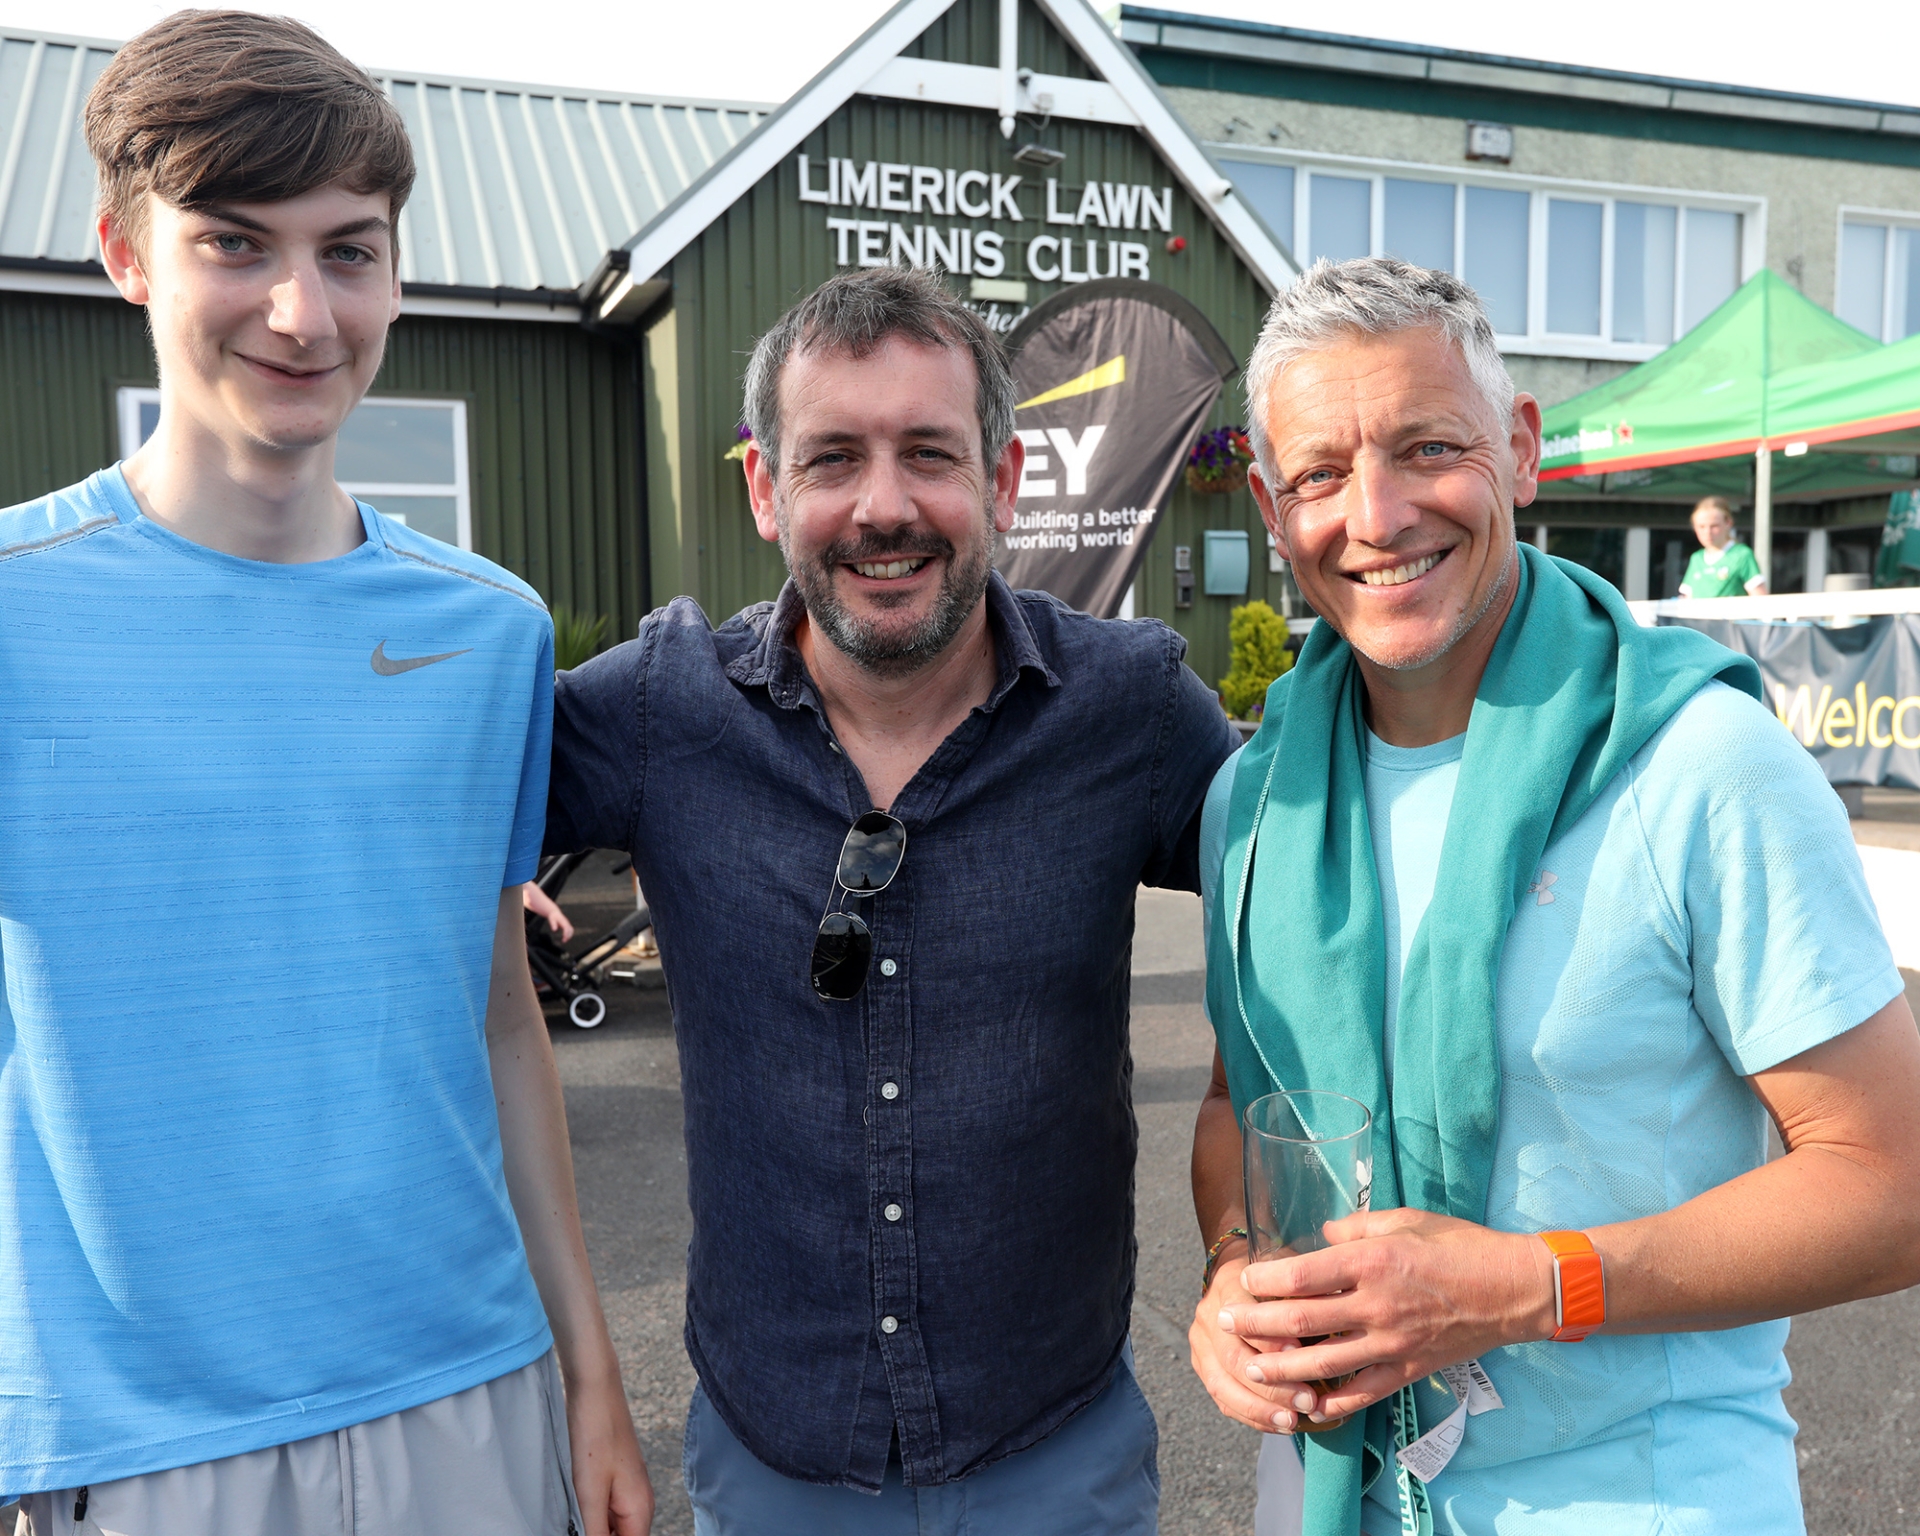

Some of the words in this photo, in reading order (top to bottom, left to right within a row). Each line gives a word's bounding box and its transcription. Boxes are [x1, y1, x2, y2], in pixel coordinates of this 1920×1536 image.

[798, 153, 1024, 222] LIMERICK
[1045, 177, 1173, 232] LAWN
[826, 216, 1006, 278] TENNIS
[1026, 234, 1151, 283] CLUB
[1013, 424, 1108, 499] EY
[1004, 530, 1078, 553] working
[1080, 526, 1134, 548] world
[1082, 512, 1095, 528] a
[1098, 506, 1157, 527] better
